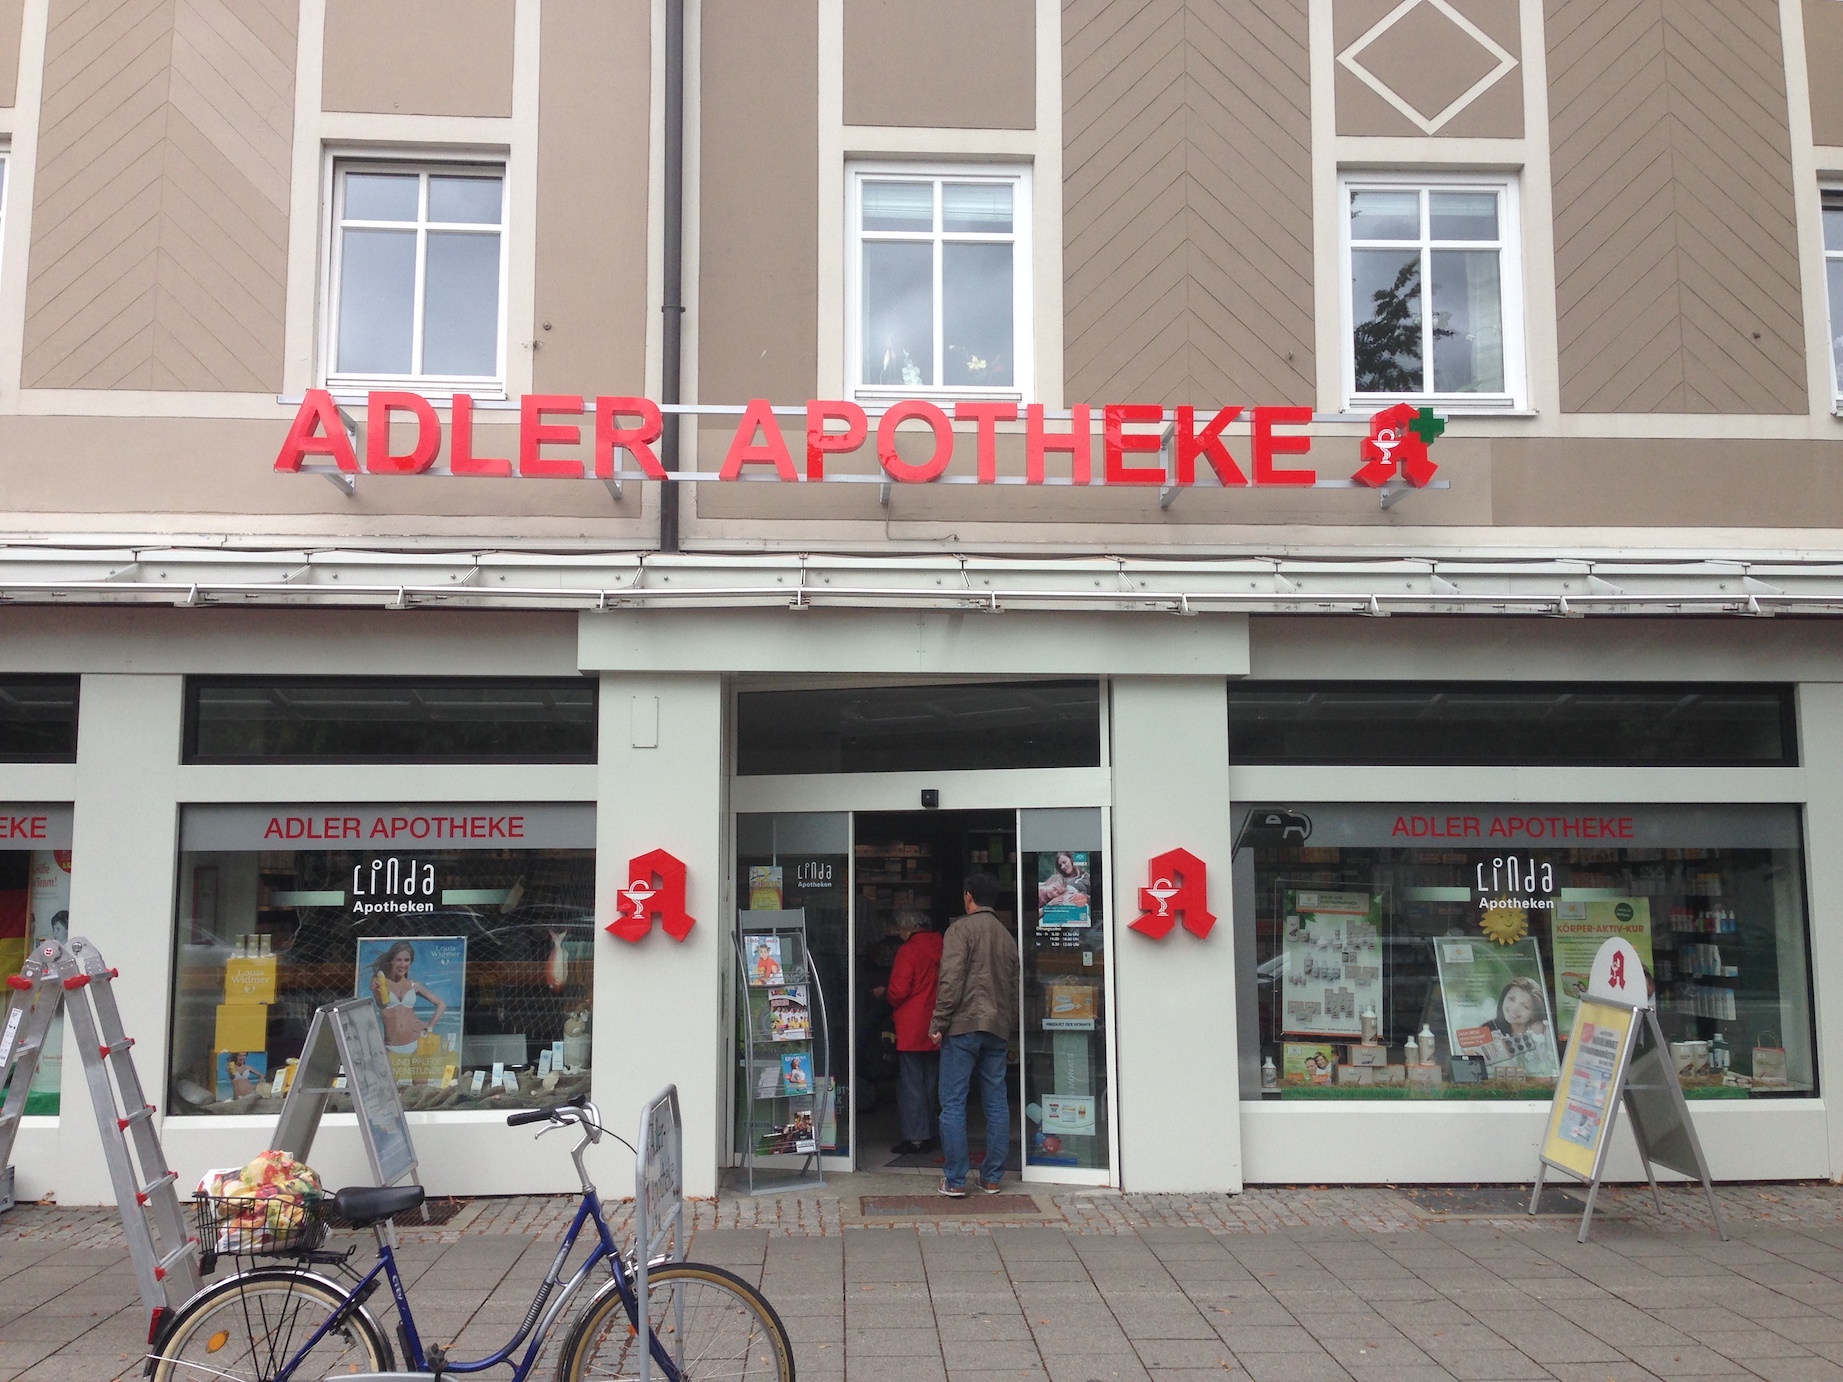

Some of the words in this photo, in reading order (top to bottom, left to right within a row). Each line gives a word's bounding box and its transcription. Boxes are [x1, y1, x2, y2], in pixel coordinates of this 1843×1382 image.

[274, 389, 670, 481] ADLER
[718, 398, 1316, 489] APOTHEKE
[264, 817, 361, 839] ADLER
[369, 816, 525, 838] APOTHEKE
[1392, 816, 1481, 838] ADLER
[1489, 817, 1635, 839] APOTHEKE
[353, 900, 434, 914] Apotheken
[1478, 897, 1554, 909] Apotheken
[1556, 923, 1645, 933] KÖRPER-AKTIV-KUR
[431, 950, 461, 958] Widmer
[237, 968, 265, 977] Louis
[231, 976, 270, 984] Widmer
